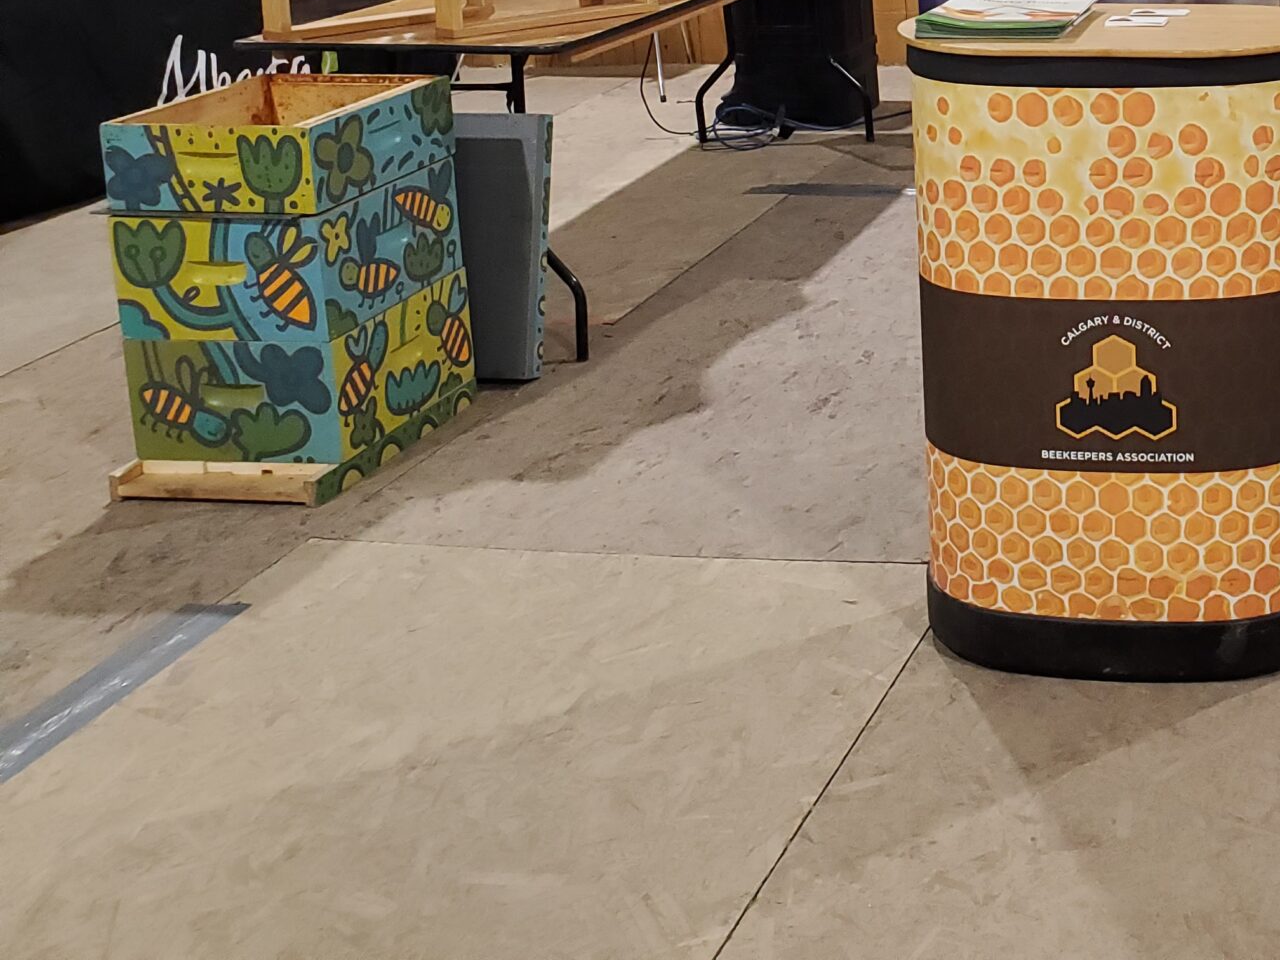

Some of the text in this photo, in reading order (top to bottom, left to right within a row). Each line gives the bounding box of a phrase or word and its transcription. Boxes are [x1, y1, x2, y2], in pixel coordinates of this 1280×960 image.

[1060, 315, 1171, 350] CALGARY & DISTRICT
[1041, 449, 1195, 462] BEEKEEPERS ASSOCIATION
